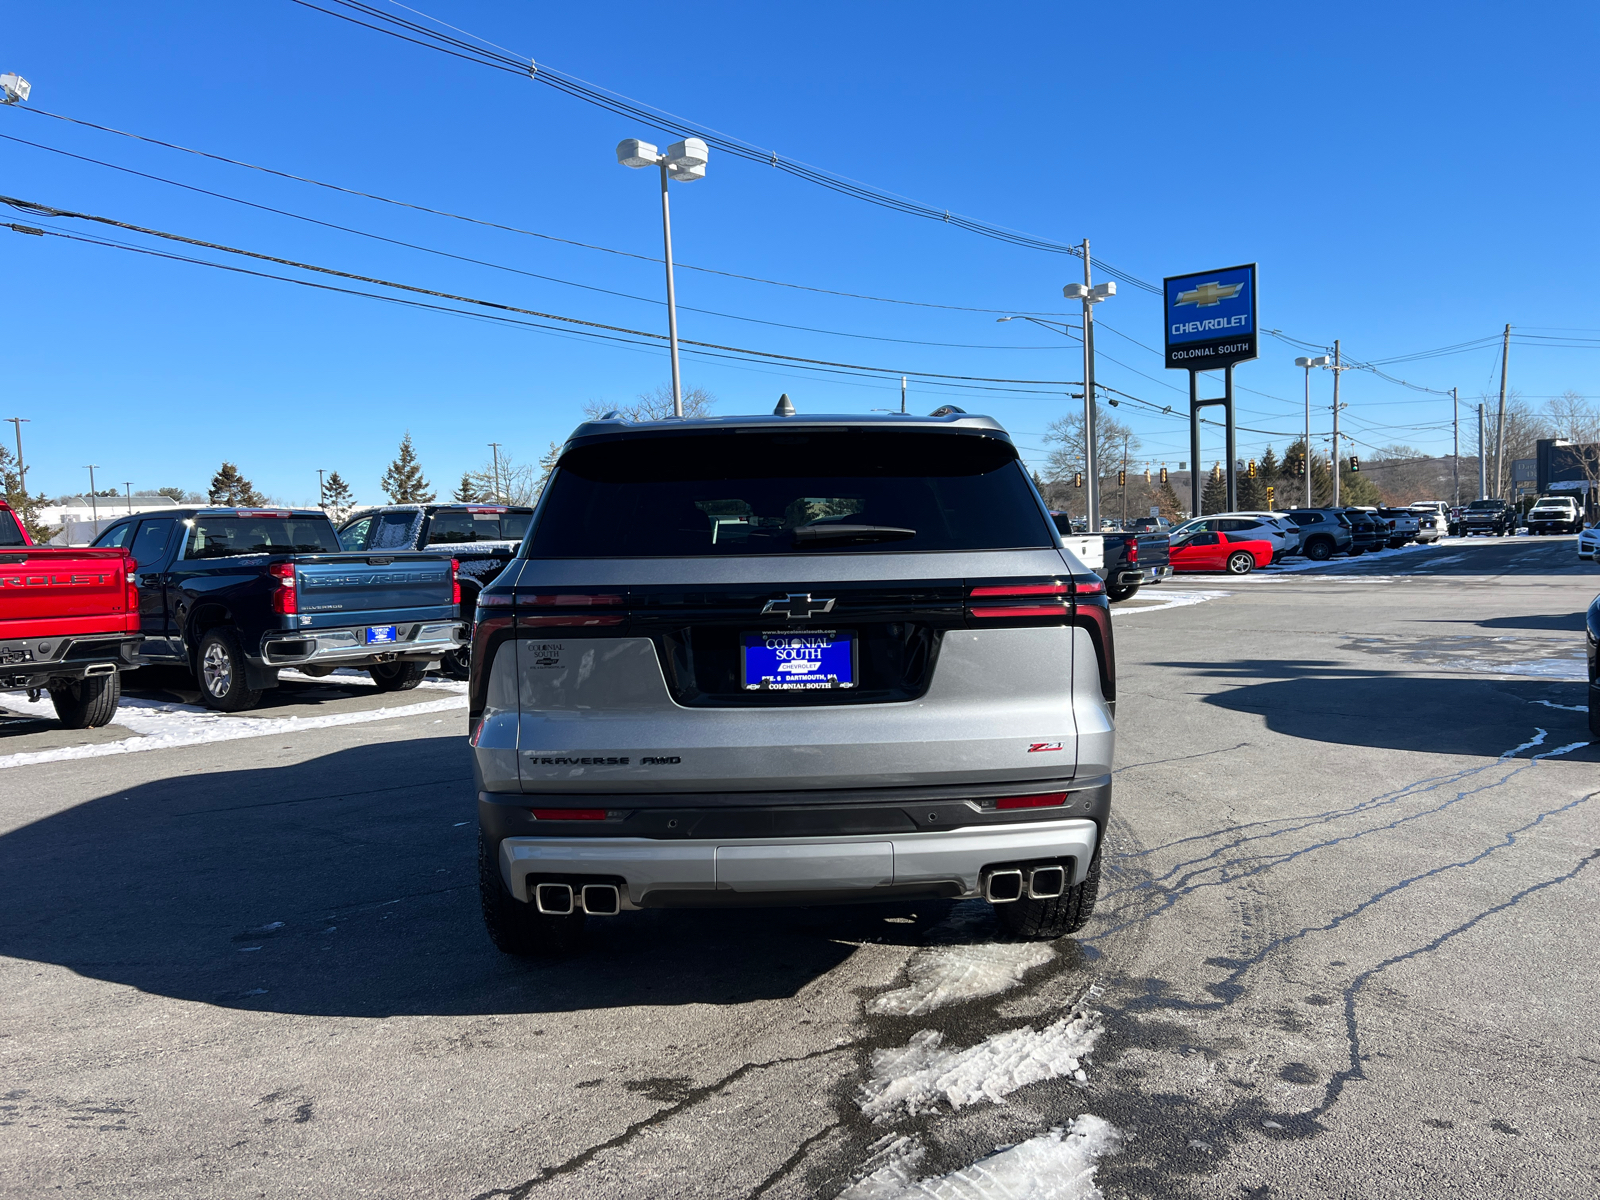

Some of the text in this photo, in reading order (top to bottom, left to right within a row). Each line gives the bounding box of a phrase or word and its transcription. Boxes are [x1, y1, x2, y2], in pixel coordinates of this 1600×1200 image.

[1171, 314, 1248, 335] CHEVROLET
[1171, 342, 1249, 360] COLONIAL SOUTH
[309, 572, 446, 587] CHEVROLET
[766, 638, 832, 650] COLONIAL
[534, 650, 560, 658] SOUTH
[776, 649, 822, 660] SOUTH
[529, 755, 681, 765] TRAVERSE AWD
